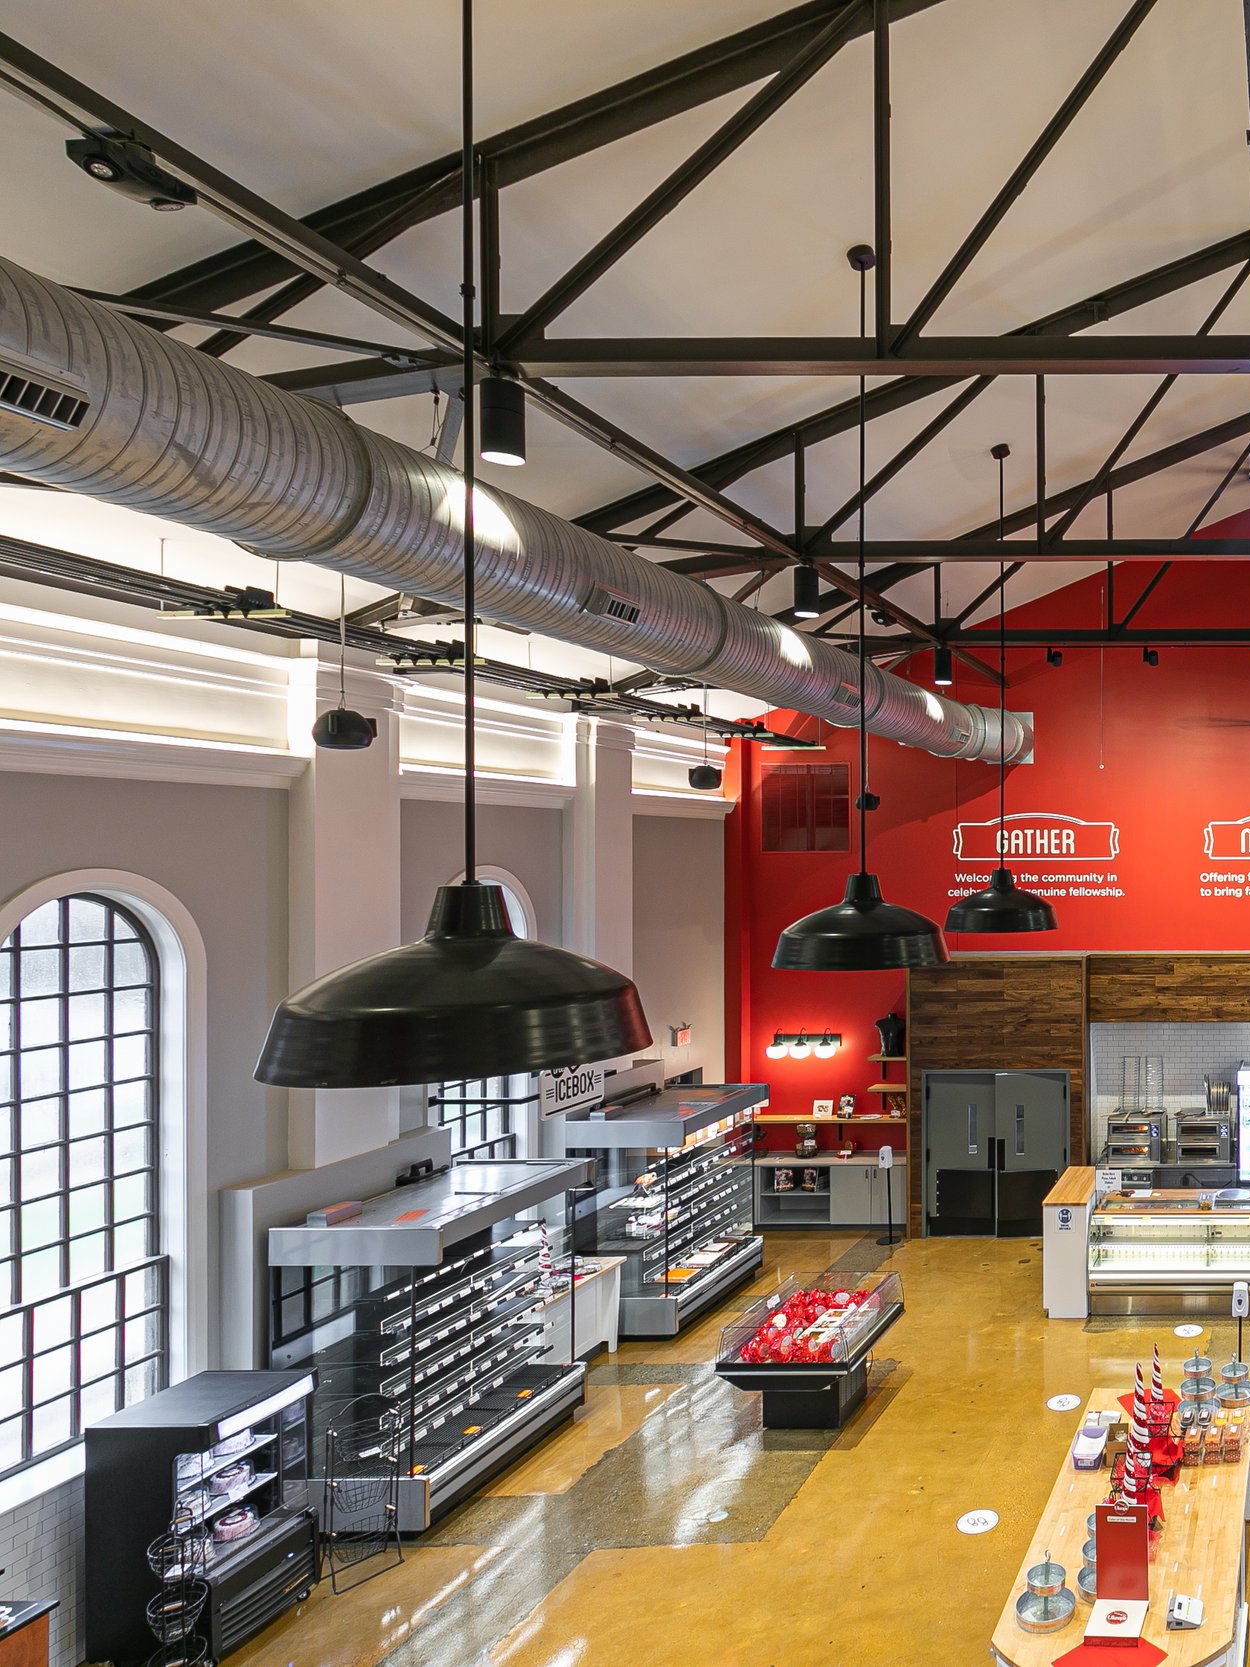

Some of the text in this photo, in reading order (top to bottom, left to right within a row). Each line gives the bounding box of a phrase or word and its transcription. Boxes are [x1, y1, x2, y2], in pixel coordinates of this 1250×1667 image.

[996, 829, 1075, 854] GATHER
[1020, 873, 1039, 882] the
[1041, 873, 1104, 884] community
[1107, 872, 1118, 882] in
[1200, 872, 1245, 884] Offering
[1069, 886, 1126, 898] fellowship.
[1200, 887, 1212, 896] to
[1214, 886, 1243, 898] bring
[555, 1070, 595, 1103] ICEBOX
